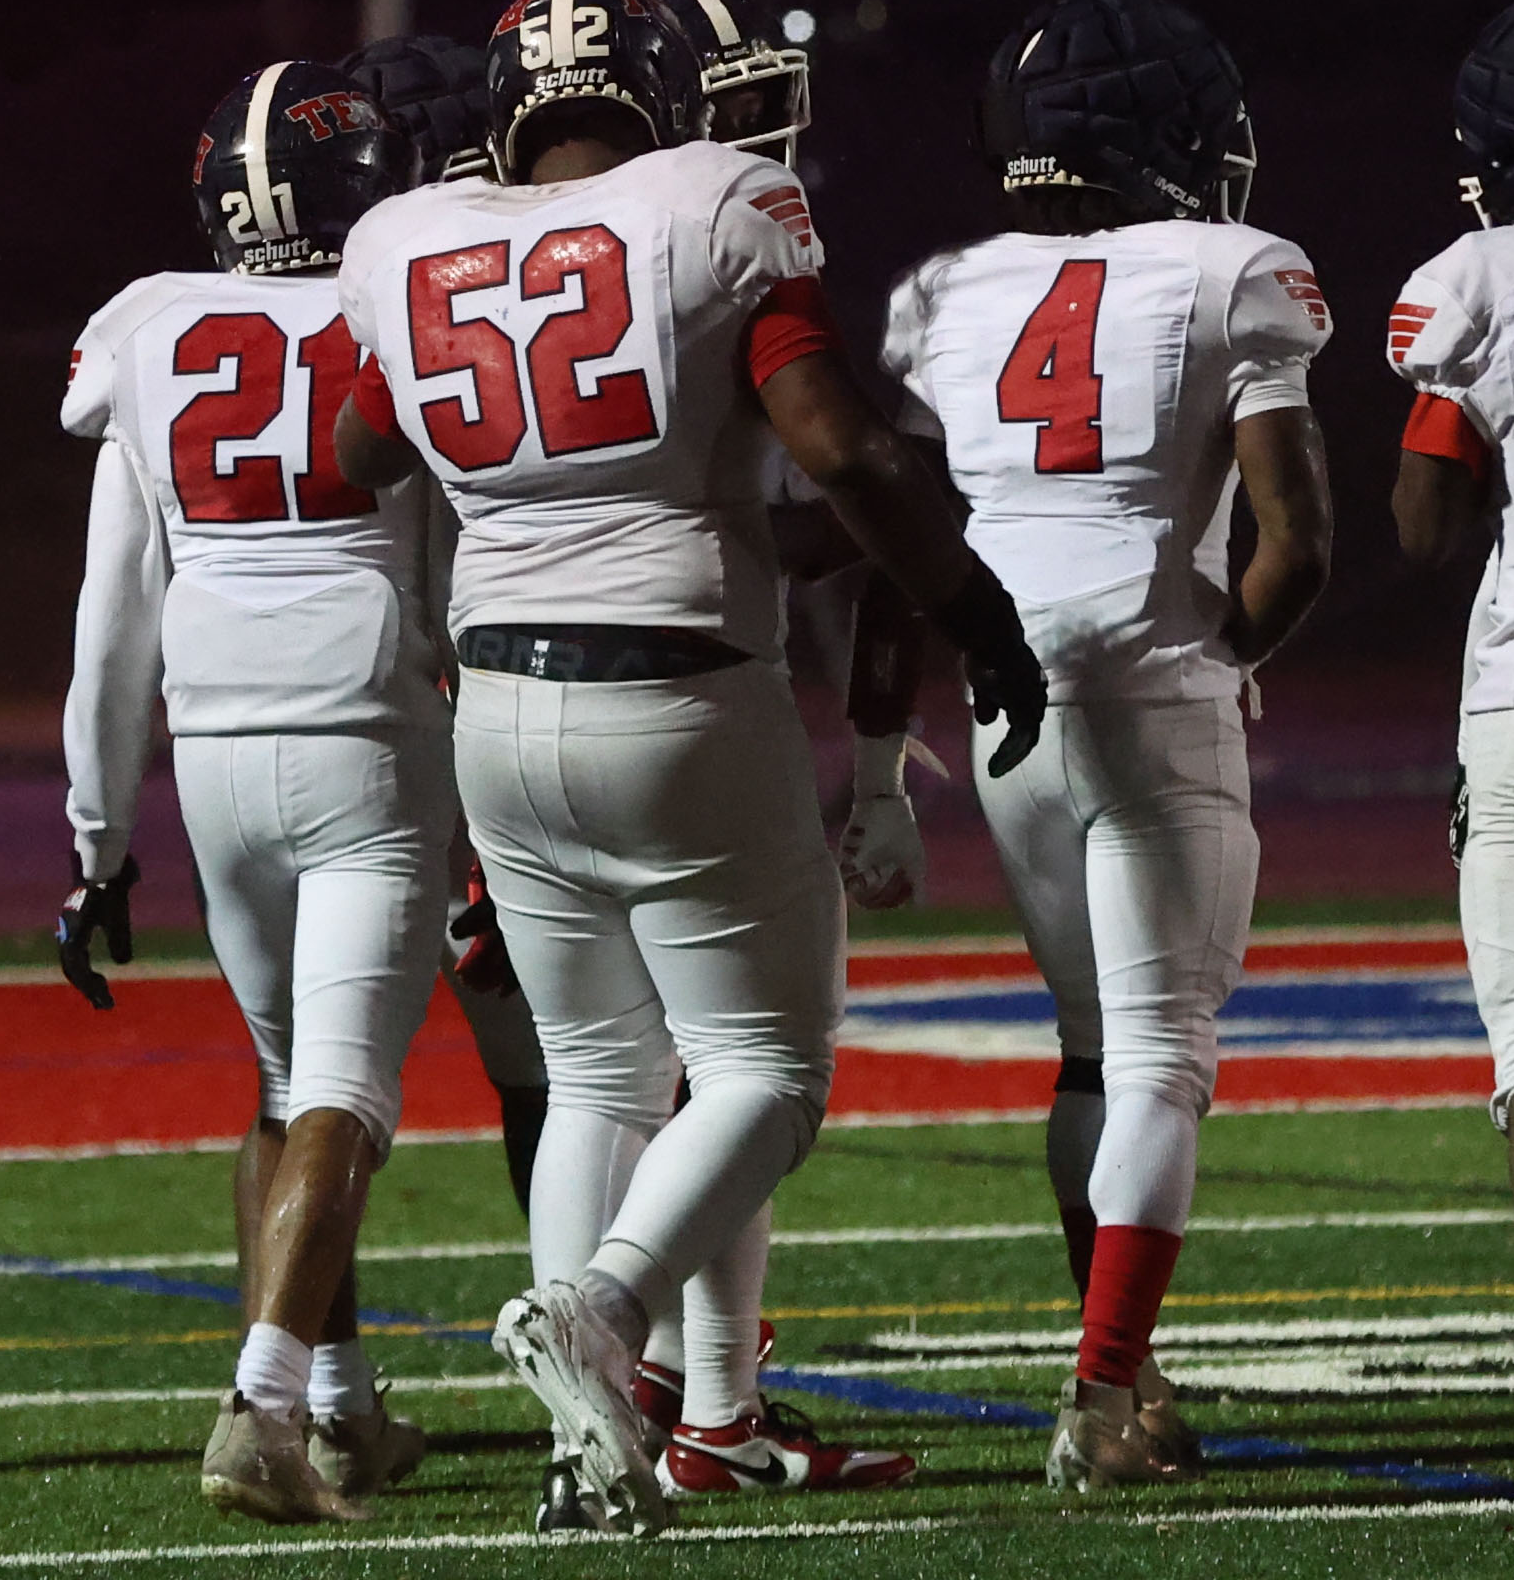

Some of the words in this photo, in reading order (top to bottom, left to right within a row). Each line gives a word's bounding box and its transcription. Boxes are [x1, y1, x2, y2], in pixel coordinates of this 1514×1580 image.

[519, 6, 611, 71] 52
[535, 66, 609, 94] schutt
[1007, 155, 1057, 177] schutt
[219, 182, 300, 244] 21
[243, 237, 312, 266] schutt
[407, 223, 660, 473] 52
[996, 258, 1107, 474] 4
[170, 313, 379, 523] 21
